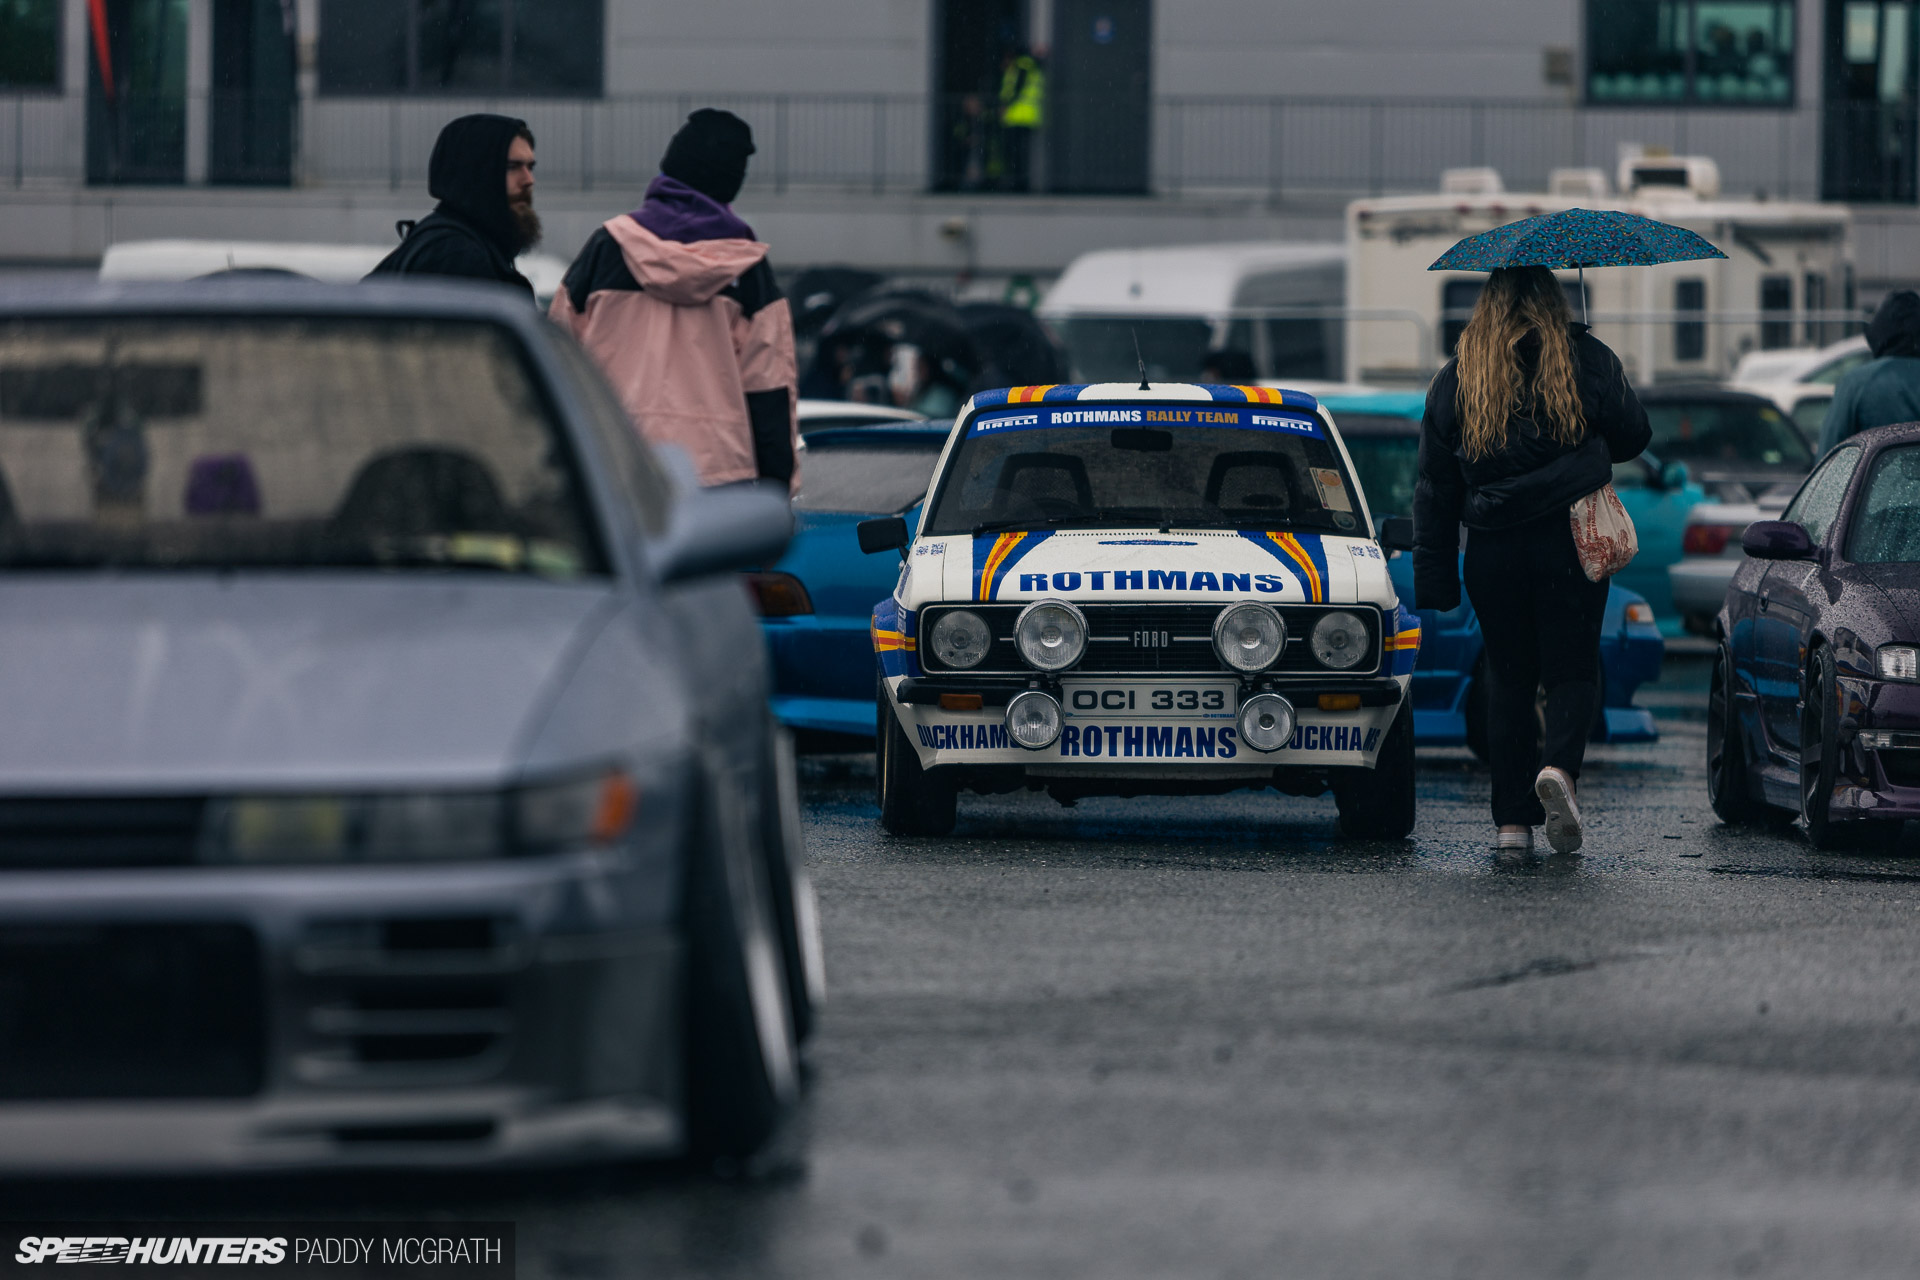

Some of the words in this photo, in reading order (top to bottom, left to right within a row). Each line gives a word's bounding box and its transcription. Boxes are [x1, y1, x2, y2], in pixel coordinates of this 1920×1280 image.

[977, 415, 1038, 431] PIRELLI
[1051, 410, 1142, 424] ROTHMANS
[1146, 410, 1192, 422] RALLY
[1195, 411, 1239, 424] TEAM
[1252, 415, 1313, 431] PIRELLI
[1019, 570, 1284, 593] ROTHMANS
[1134, 631, 1168, 648] FORD
[1072, 690, 1135, 709] OCI
[1151, 690, 1225, 709] 333
[916, 724, 1021, 749] DUCKHAM
[1060, 725, 1237, 758] ROTHMANS
